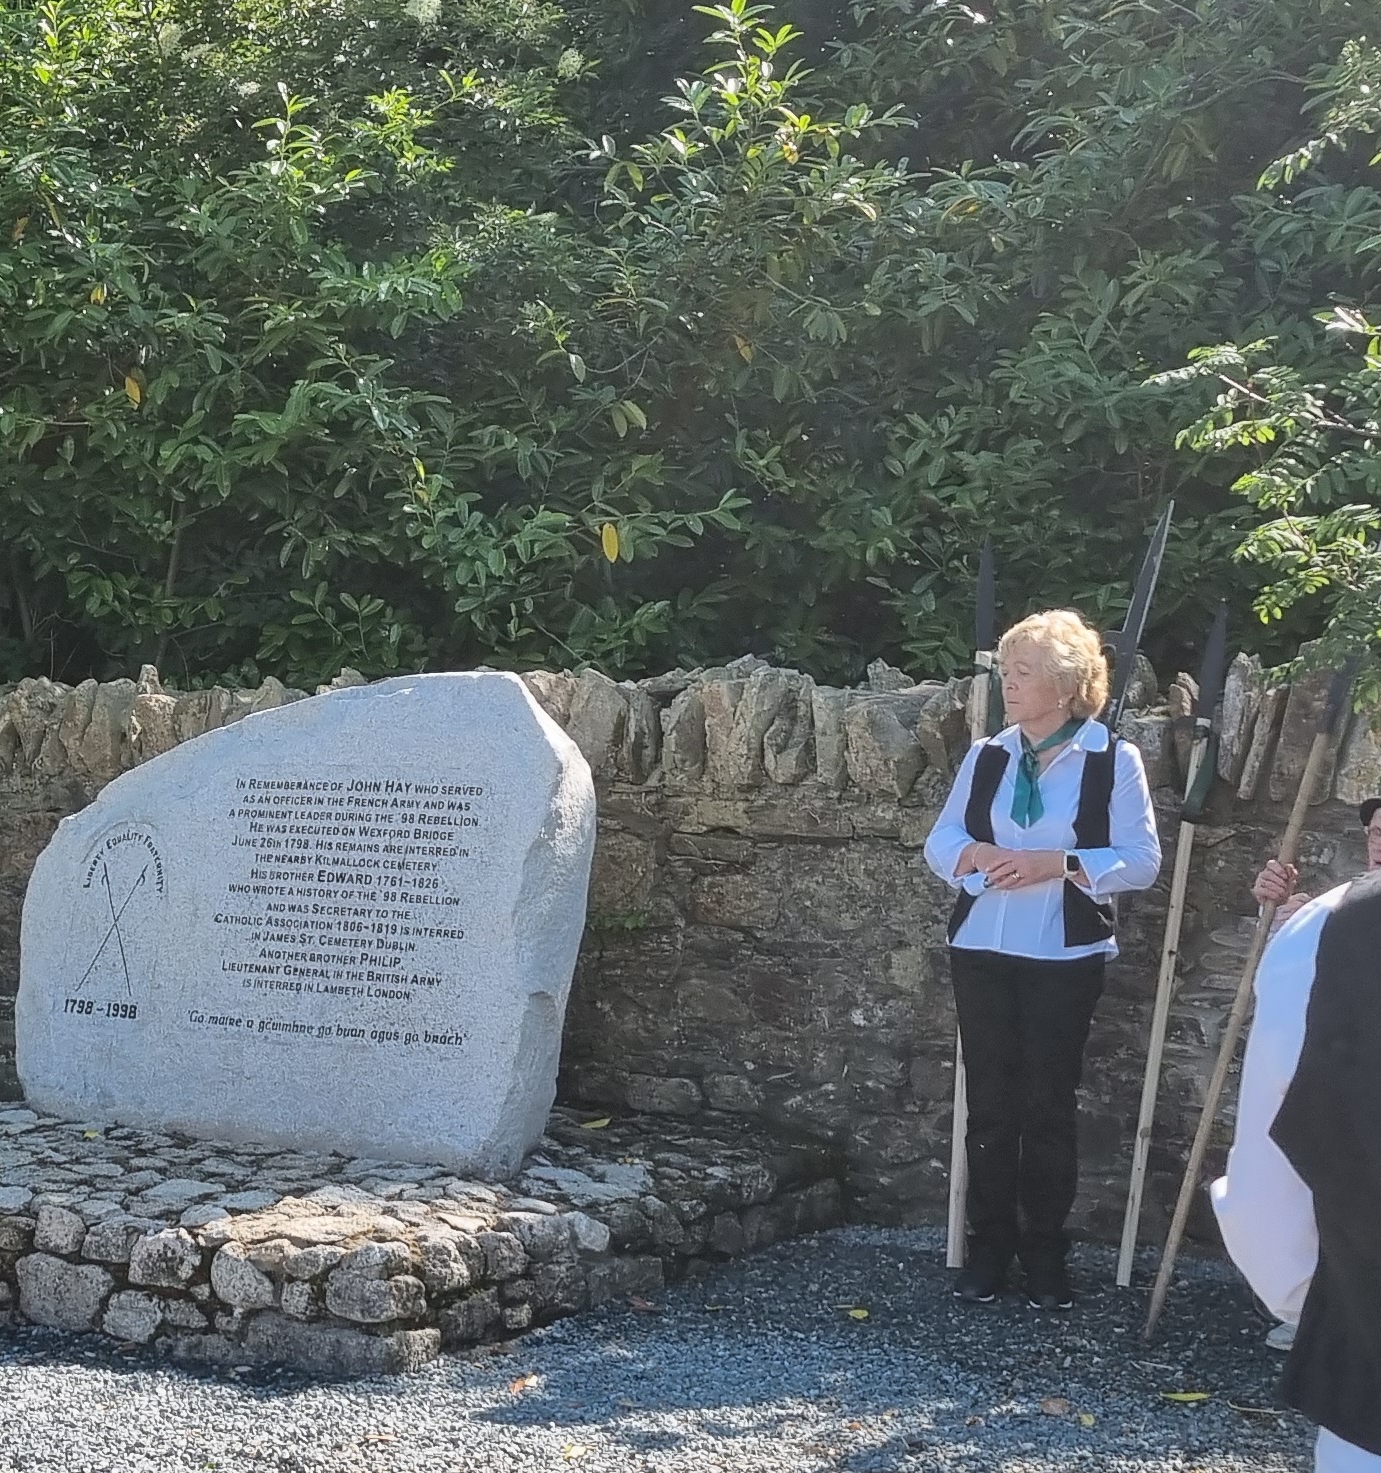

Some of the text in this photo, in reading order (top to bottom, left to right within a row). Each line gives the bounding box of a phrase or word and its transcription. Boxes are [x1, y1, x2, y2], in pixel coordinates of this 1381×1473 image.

[236, 779, 246, 789] IN
[330, 781, 344, 791] OF
[347, 779, 380, 792] JOHN
[385, 780, 412, 793] HAY
[415, 784, 439, 795] WHO
[441, 785, 483, 796] SERVED
[243, 794, 471, 811] AS AN OFFICER IN THE FRENCH ARMY AND WAS
[229, 808, 236, 818] A
[238, 808, 293, 819] PROMINENT
[294, 811, 332, 820] LEADER
[335, 811, 372, 823] DURING
[375, 814, 394, 823] THE
[249, 822, 455, 841] HE WAS EXECUTED ON WEXFORD BRIDGE
[232, 835, 257, 847] JUNE
[316, 839, 333, 850] HIS
[335, 841, 380, 853] REMAINS
[382, 844, 403, 854] ARE
[405, 844, 456, 857] INTERRED
[459, 848, 470, 858] IN
[83, 847, 104, 888] LIBERTY
[275, 854, 313, 865] NEARBY
[315, 855, 380, 868] KILMALLOCK
[383, 860, 438, 871] CEMETERY
[251, 868, 267, 879] HIS
[269, 870, 315, 881] BROTHER
[317, 869, 372, 885] EDWARD
[228, 884, 251, 894] WHO
[252, 885, 286, 895] WROTE
[287, 886, 294, 896] A
[296, 888, 339, 899] HISTORY
[340, 890, 355, 899] OF
[357, 891, 377, 901] THE
[266, 902, 285, 912] AND
[288, 903, 309, 914] WAS
[311, 903, 373, 918] SECRETARY
[375, 909, 388, 919] TO
[213, 913, 263, 926] CATHOLIC
[265, 915, 333, 930] ASSOCIATION
[400, 926, 410, 936] IS
[412, 927, 464, 939] INTERRED
[262, 930, 296, 943] JAMES
[319, 935, 373, 949] CEMETERY
[259, 948, 307, 962] ANOTHER
[309, 952, 356, 965] BROTHER
[222, 960, 442, 987] LIEUTENANT GENERAL IN THE BRITISH ARMY
[242, 979, 252, 988] IS
[253, 979, 301, 992] INTERRED
[304, 983, 313, 992] IN
[316, 983, 363, 997] LAMBETH
